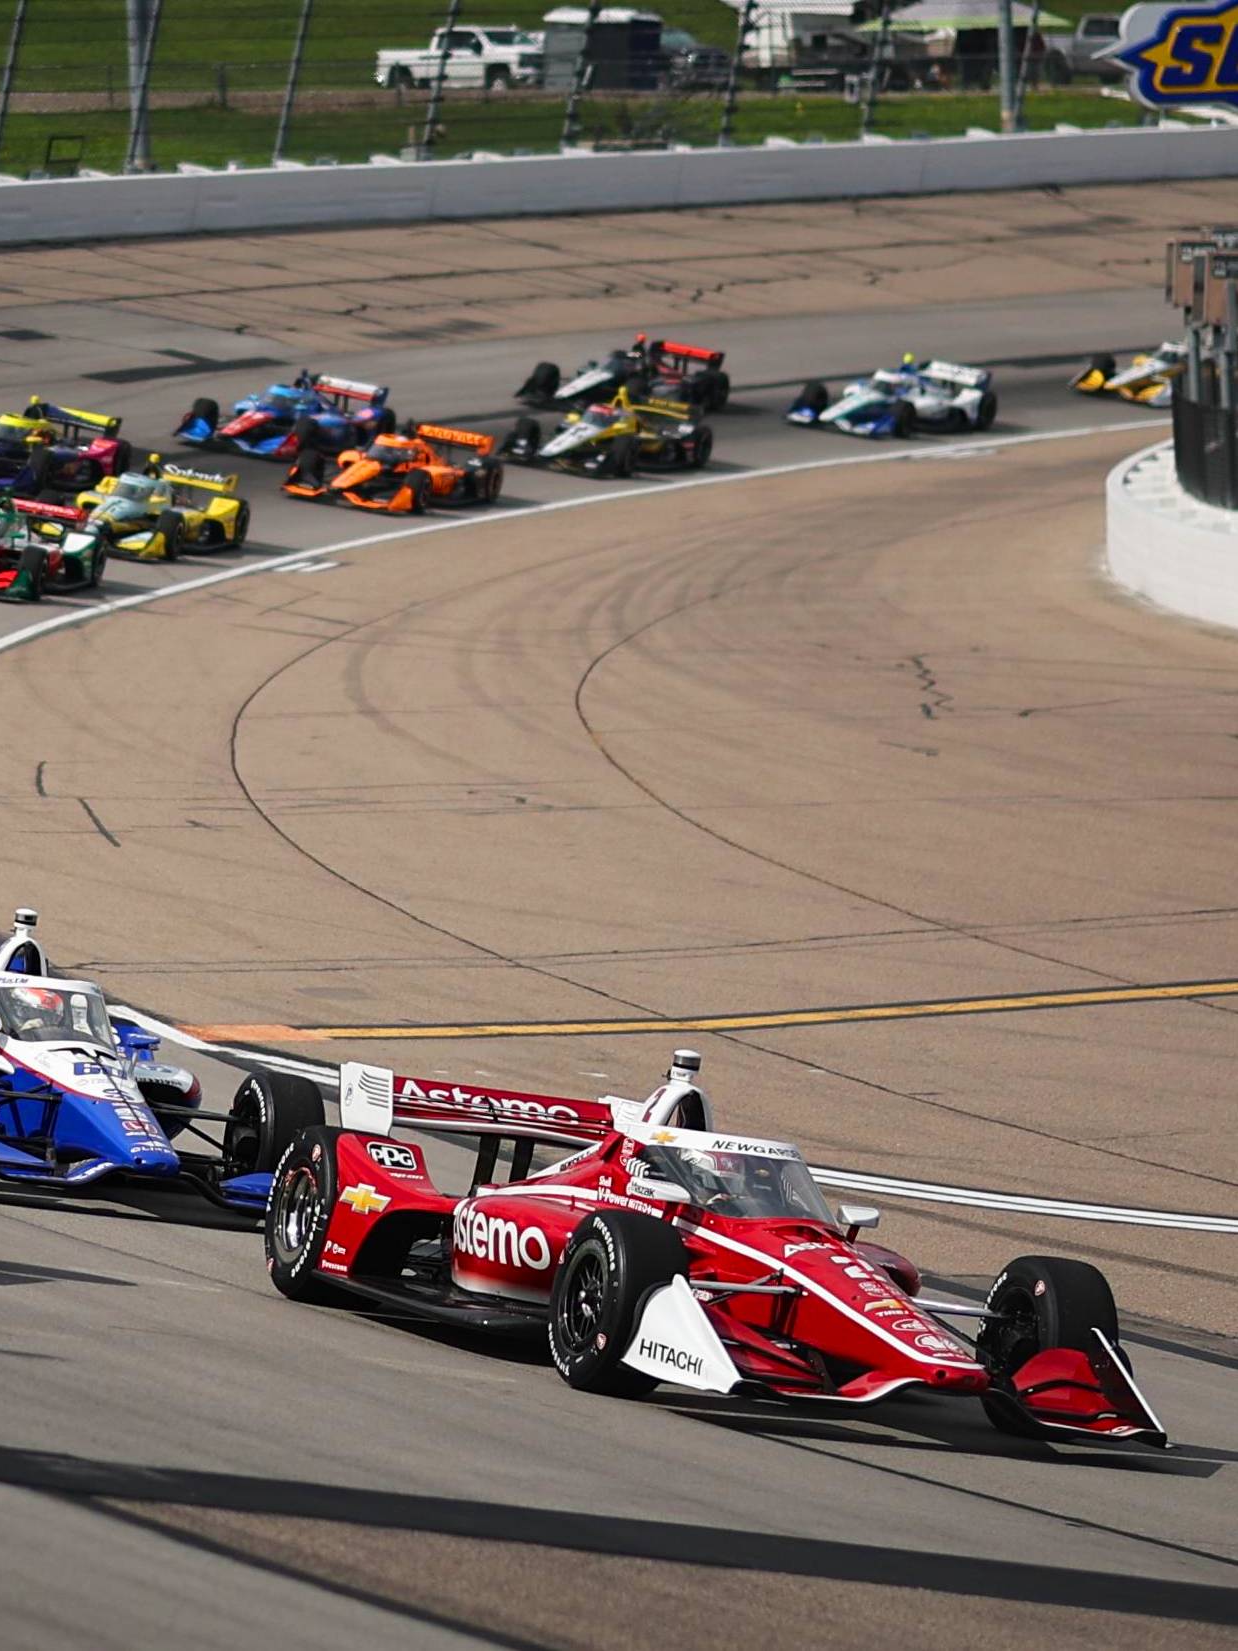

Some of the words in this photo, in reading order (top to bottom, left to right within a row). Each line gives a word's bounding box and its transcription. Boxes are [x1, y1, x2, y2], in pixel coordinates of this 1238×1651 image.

[398, 1079, 581, 1126] Astemo
[370, 1146, 413, 1167] PPG
[452, 1197, 551, 1271] Astemo
[593, 1216, 616, 1272] Firestone
[639, 1338, 704, 1375] HITACHI
